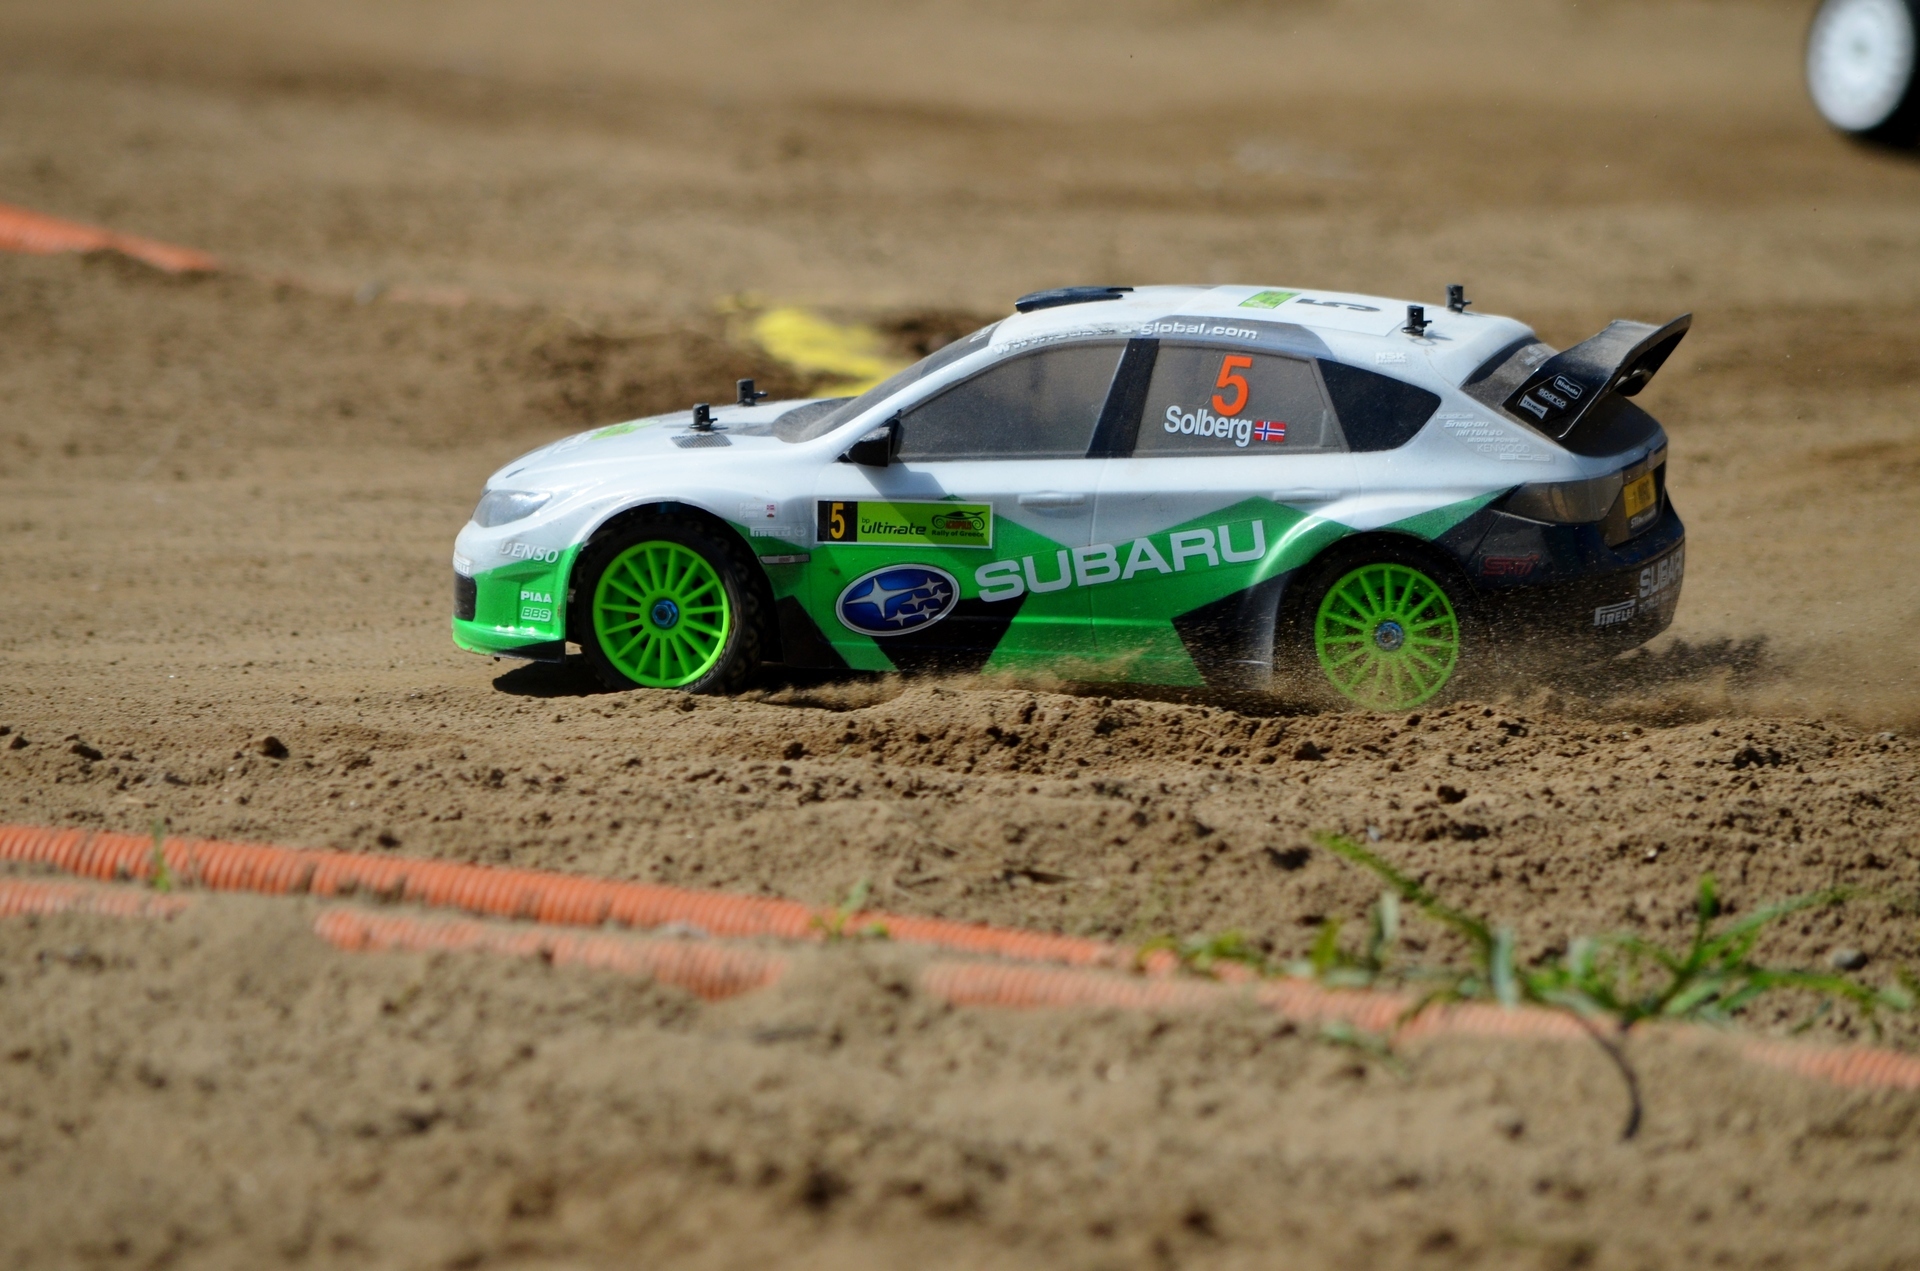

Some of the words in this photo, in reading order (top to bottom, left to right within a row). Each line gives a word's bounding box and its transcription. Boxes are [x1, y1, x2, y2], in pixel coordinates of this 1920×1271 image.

[1211, 354, 1253, 417] 5
[1537, 388, 1567, 409] sparco
[1164, 405, 1253, 447] Solberg
[1444, 420, 1490, 429] Snap-on
[1471, 429, 1504, 437] TURBO
[1477, 444, 1530, 453] KENWOOD
[830, 502, 846, 540] 5
[861, 517, 870, 525] bp
[861, 521, 927, 536] ultimate
[931, 529, 949, 537] Rally
[959, 530, 985, 538] Greece
[500, 541, 559, 564] DENSO
[975, 520, 1266, 603] SUBARU
[1638, 551, 1684, 599] SUBAR
[521, 591, 552, 603] PIAA
[521, 607, 551, 621] BBS
[1594, 599, 1637, 627] PIRELLI
